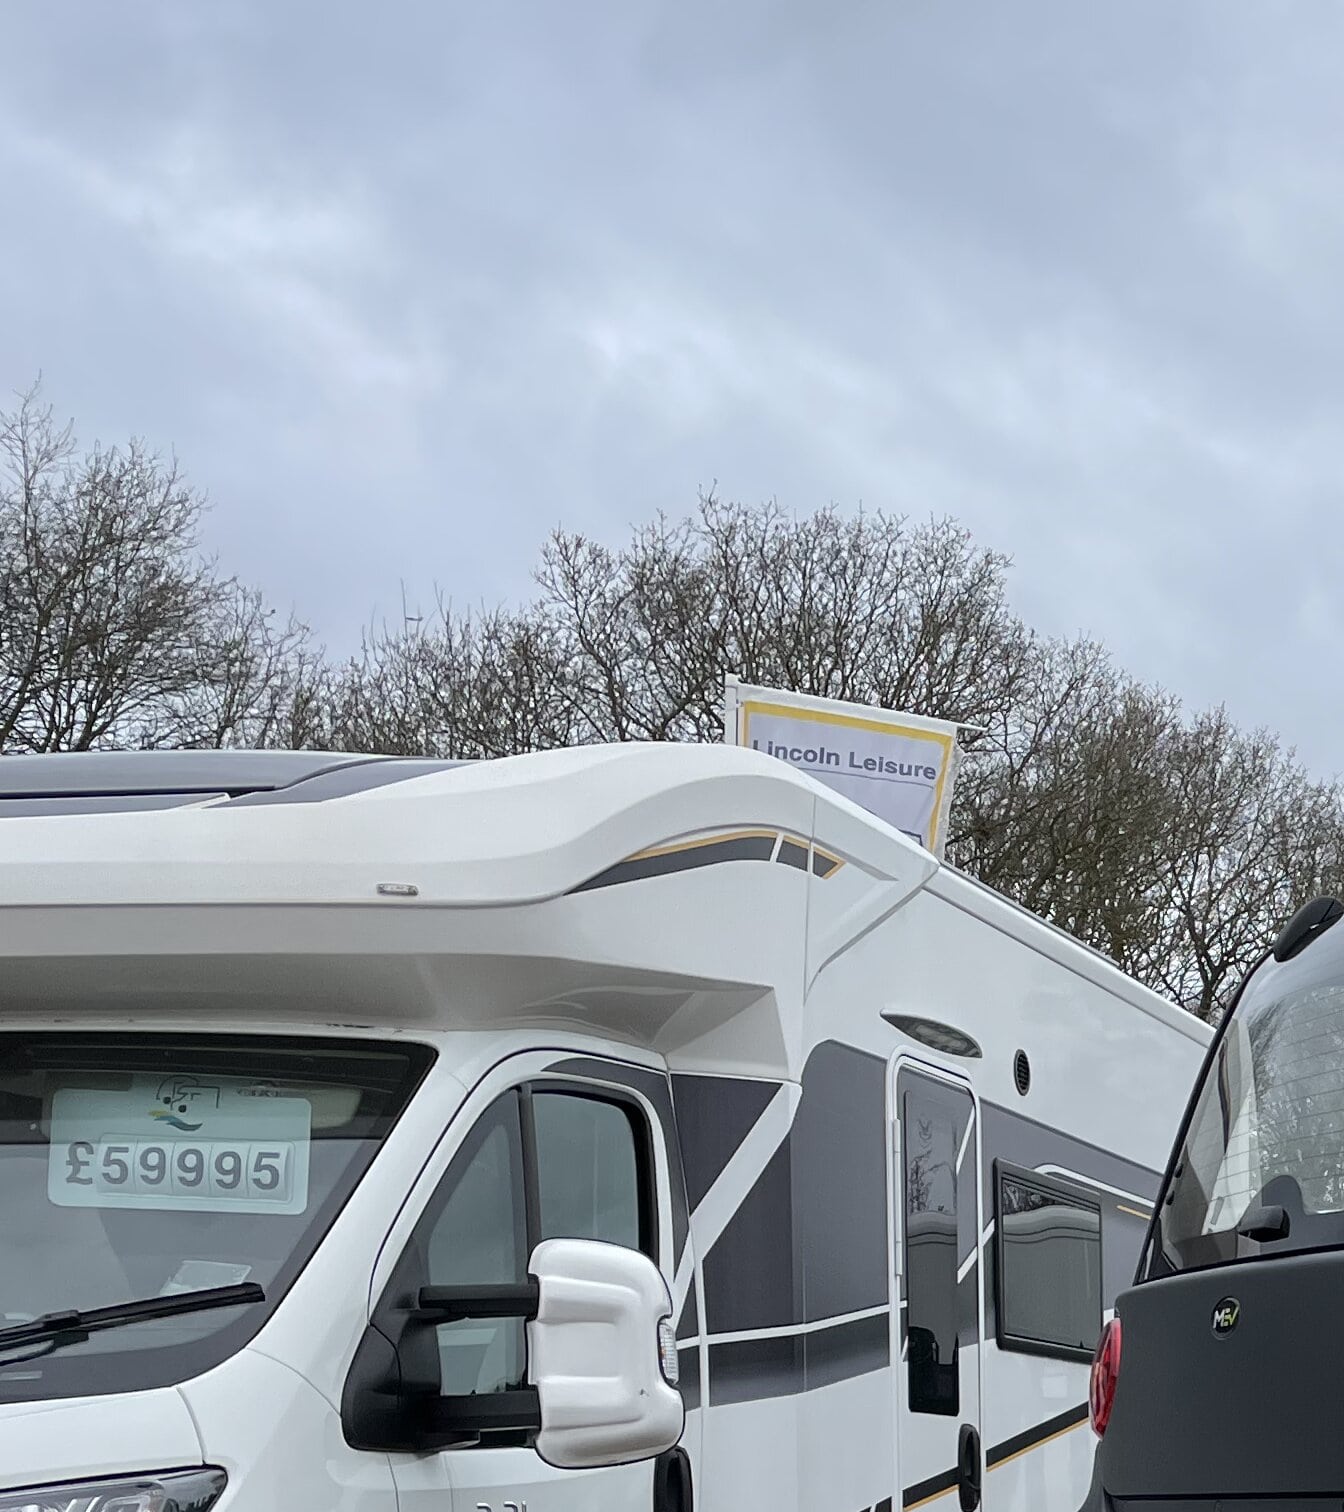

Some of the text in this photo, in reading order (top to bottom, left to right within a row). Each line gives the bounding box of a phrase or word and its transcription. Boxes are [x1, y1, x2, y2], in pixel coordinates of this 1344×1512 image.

[752, 739, 937, 781] Lincoln Leisure
[65, 1141, 281, 1191] £59995
